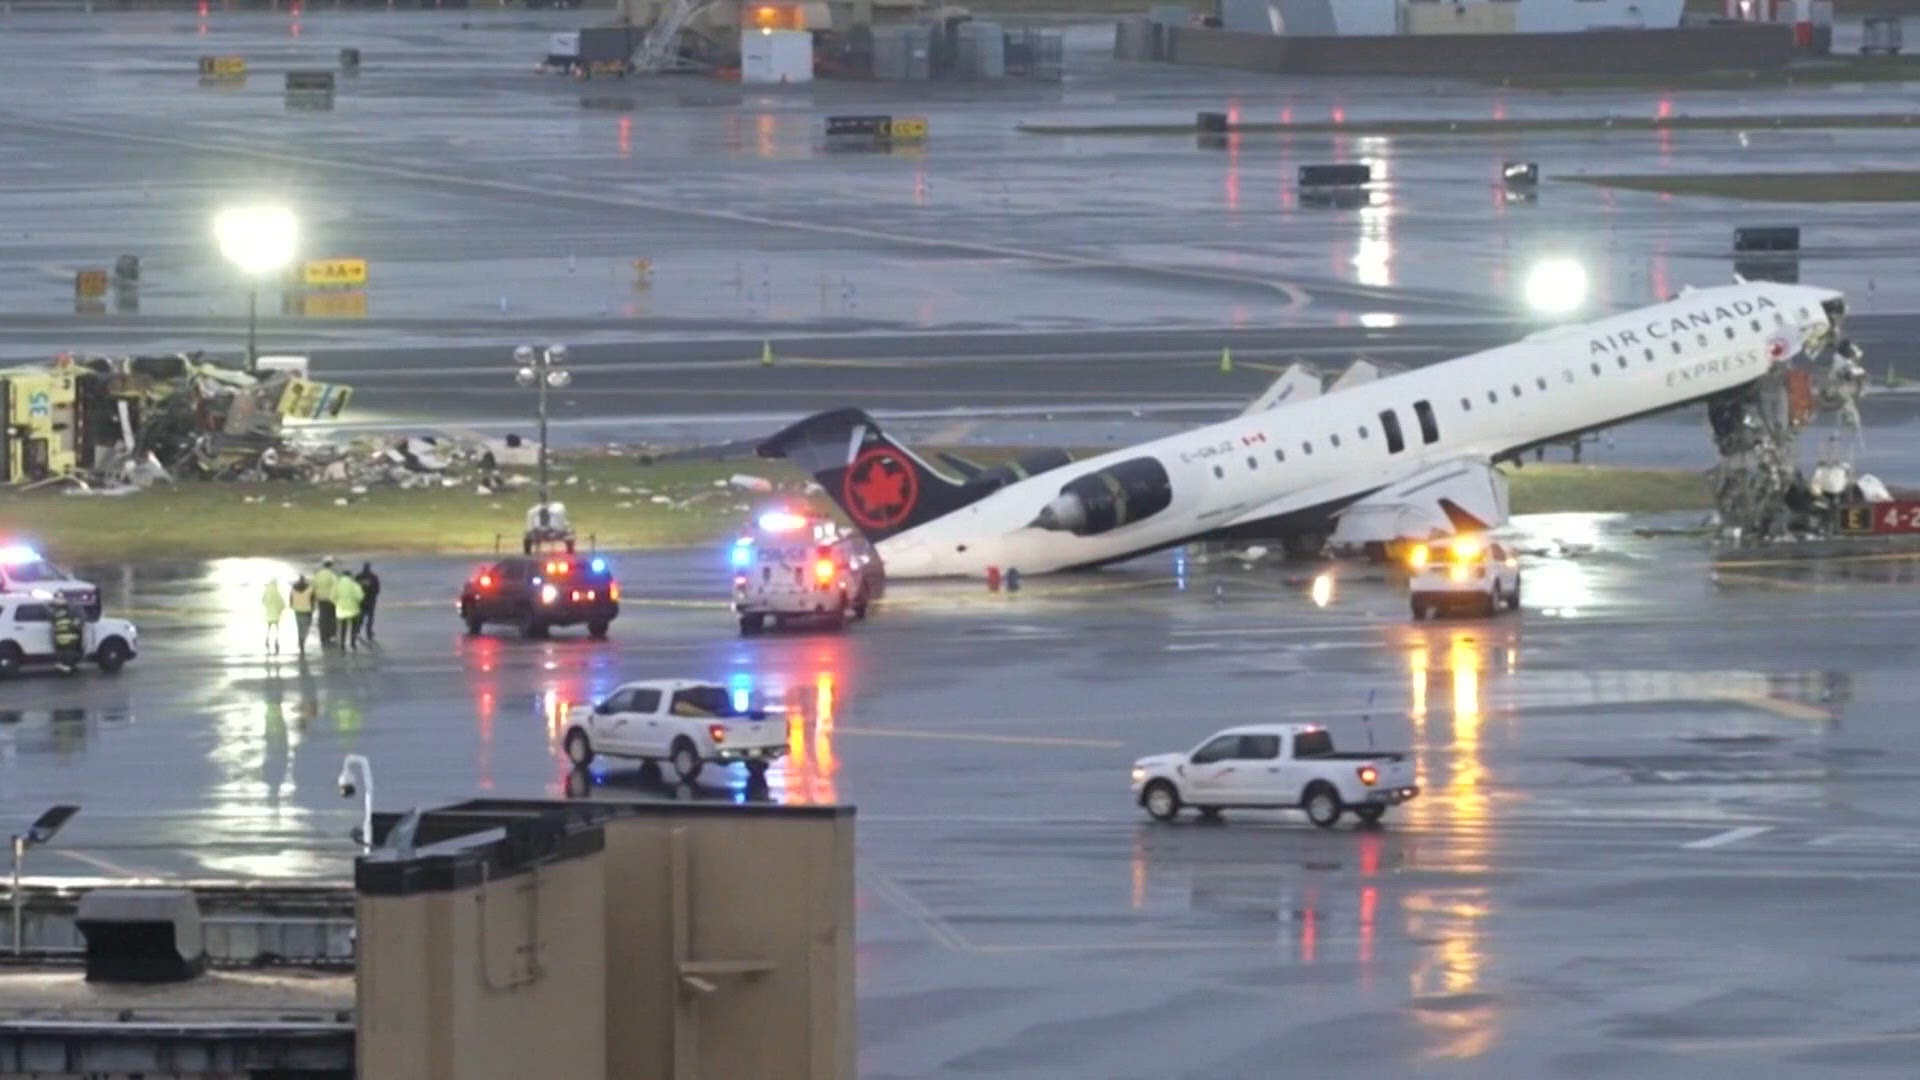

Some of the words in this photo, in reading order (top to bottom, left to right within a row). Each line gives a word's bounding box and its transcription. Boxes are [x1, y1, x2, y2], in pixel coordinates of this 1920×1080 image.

[1590, 330, 1641, 355] AIR
[1646, 296, 1776, 339] CANADA
[1666, 350, 1758, 386] EXPRESS
